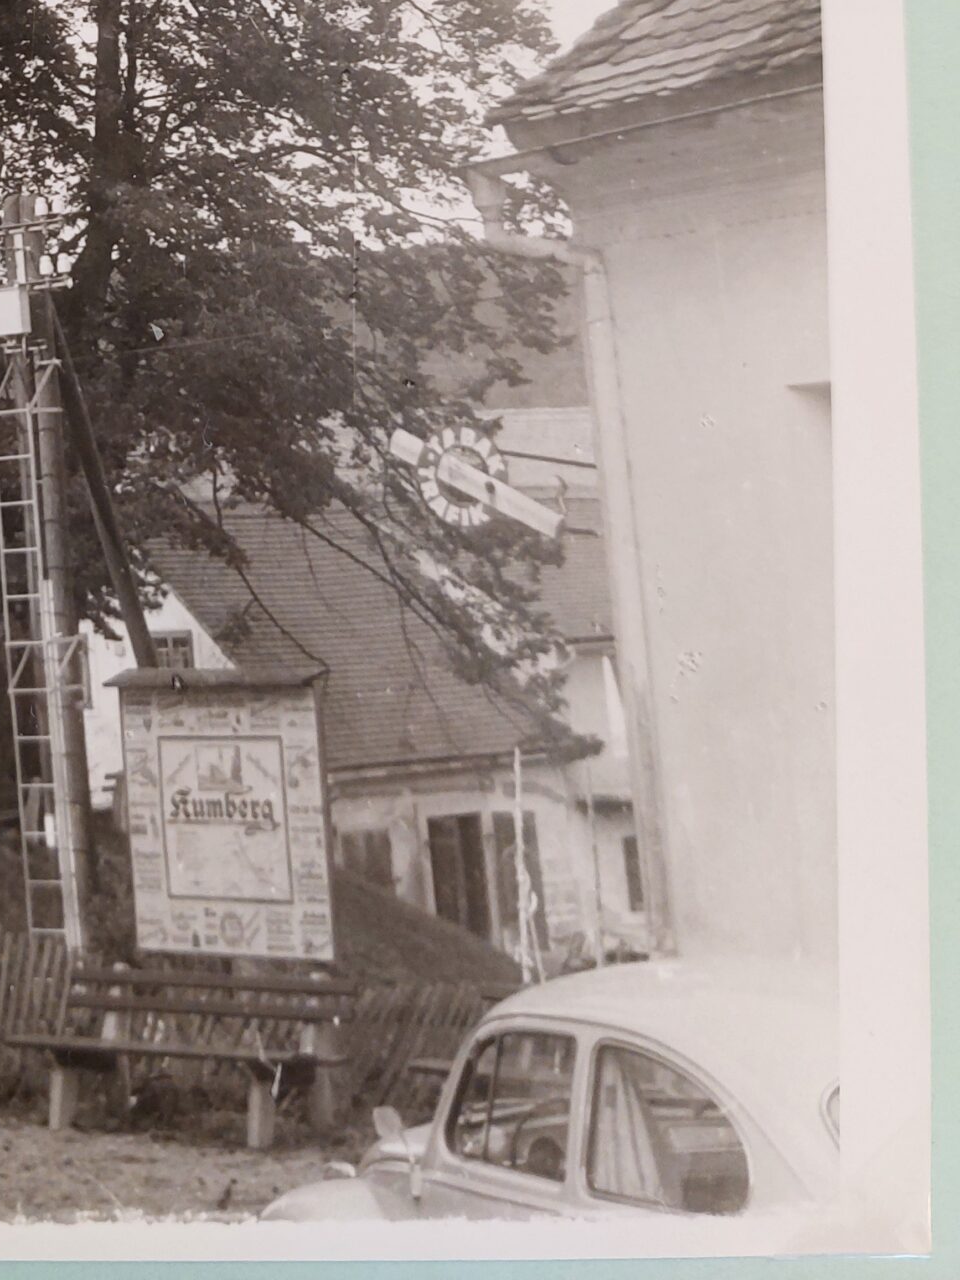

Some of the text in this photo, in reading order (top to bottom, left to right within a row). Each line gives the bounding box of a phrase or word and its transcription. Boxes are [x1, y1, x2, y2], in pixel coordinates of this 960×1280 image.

[427, 427, 505, 475] TABAK
[417, 466, 491, 527] TRAFIK
[169, 785, 281, 836] Kumberg
